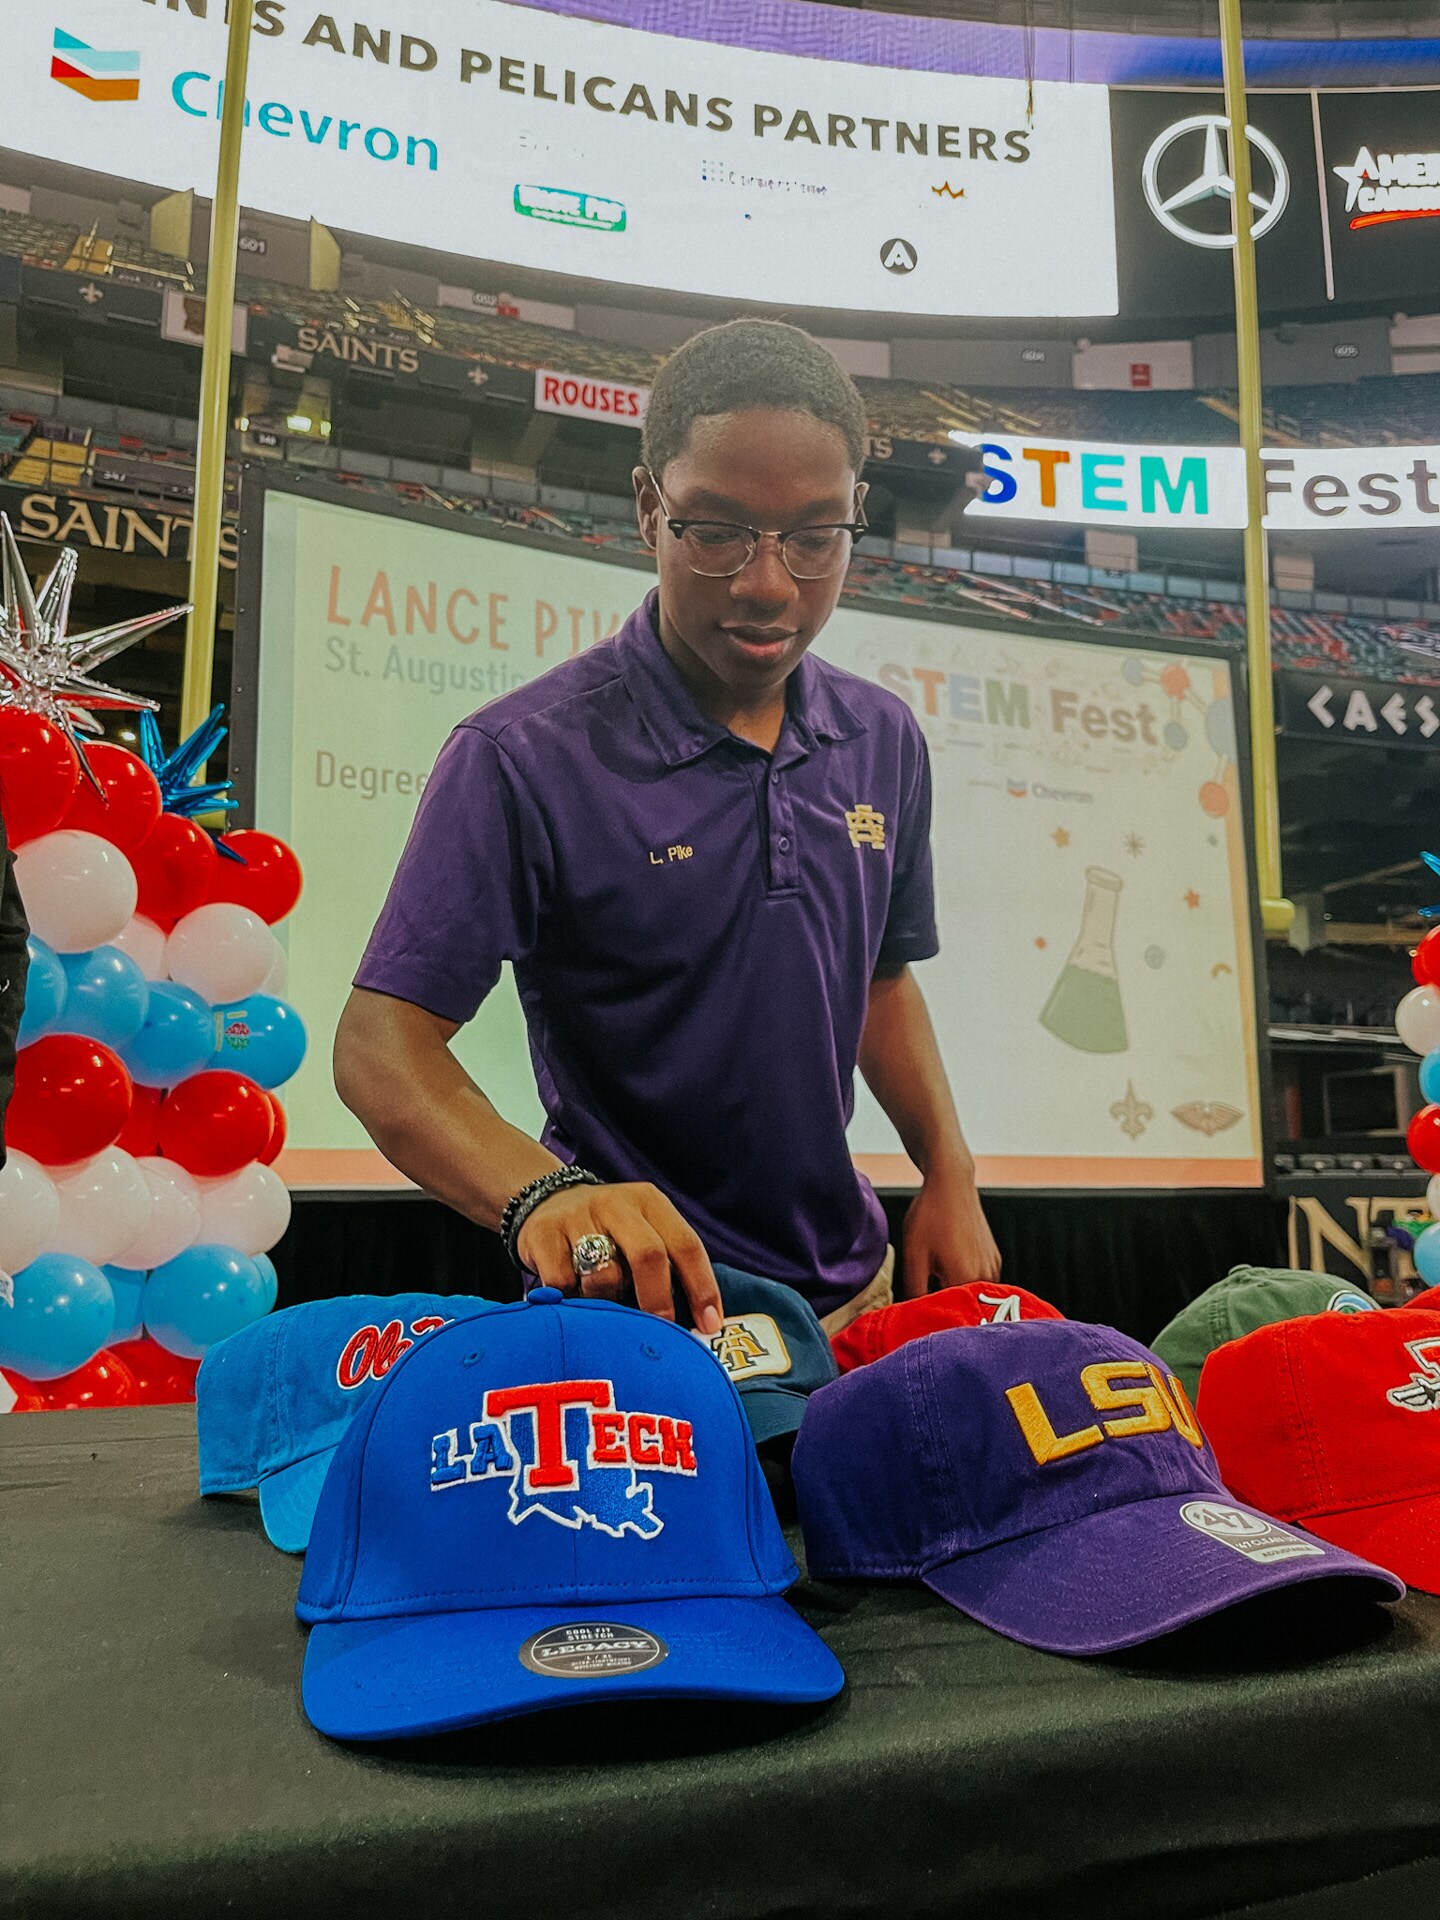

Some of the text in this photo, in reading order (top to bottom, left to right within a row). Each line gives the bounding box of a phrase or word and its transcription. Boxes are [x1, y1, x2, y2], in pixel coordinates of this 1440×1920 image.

[171, 71, 438, 171] Chevron
[302, 14, 438, 71] AND
[460, 48, 733, 132] PELICANS
[754, 103, 1031, 163] PARTNERS
[298, 326, 420, 374] SAINTS
[543, 375, 640, 417] ROUSES
[981, 443, 1440, 517] STEM Fest
[327, 564, 510, 652] LANCE
[324, 636, 370, 677] St.
[878, 662, 1158, 747] STEM Fest
[667, 844, 694, 862] Pike
[1005, 1361, 1204, 1466] LSU
[541, 1640, 648, 1657] LEGACY
